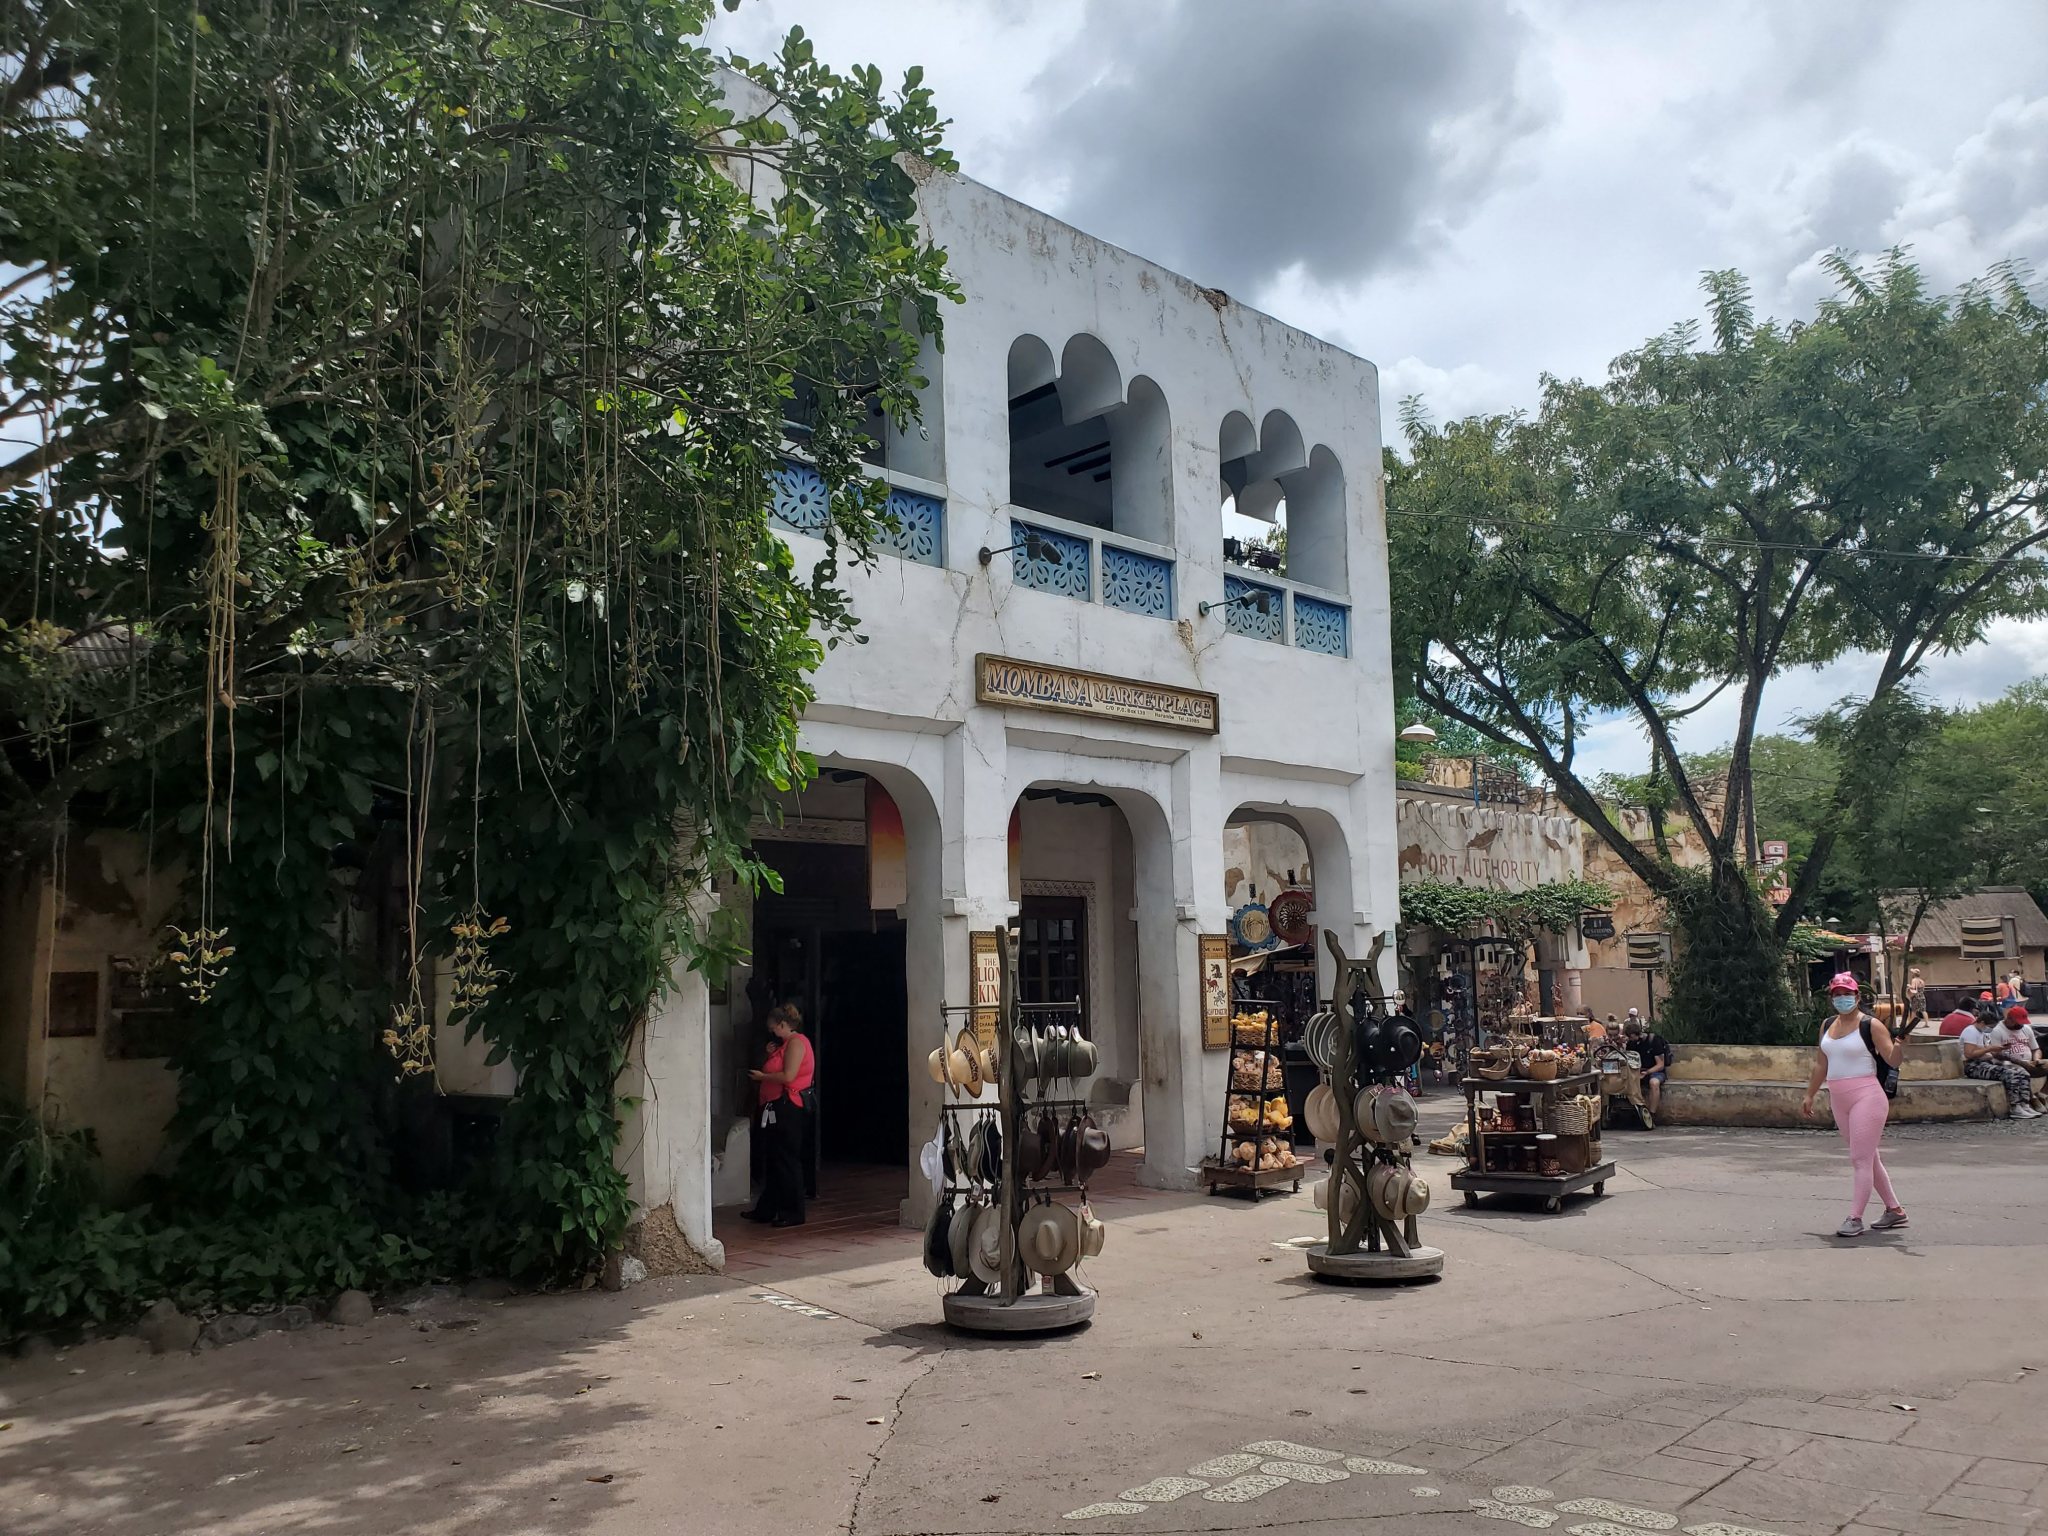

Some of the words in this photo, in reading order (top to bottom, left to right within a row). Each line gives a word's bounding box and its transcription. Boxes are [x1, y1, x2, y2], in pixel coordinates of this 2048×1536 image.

[987, 663, 1093, 707] MOMBASA
[1093, 682, 1212, 720] MARKETPLACE
[1421, 852, 1458, 877] PORT
[1464, 856, 1541, 882] AUTHORITY
[983, 958, 997, 966] THE
[978, 966, 1000, 982] LION
[978, 984, 1000, 1003] KIN
